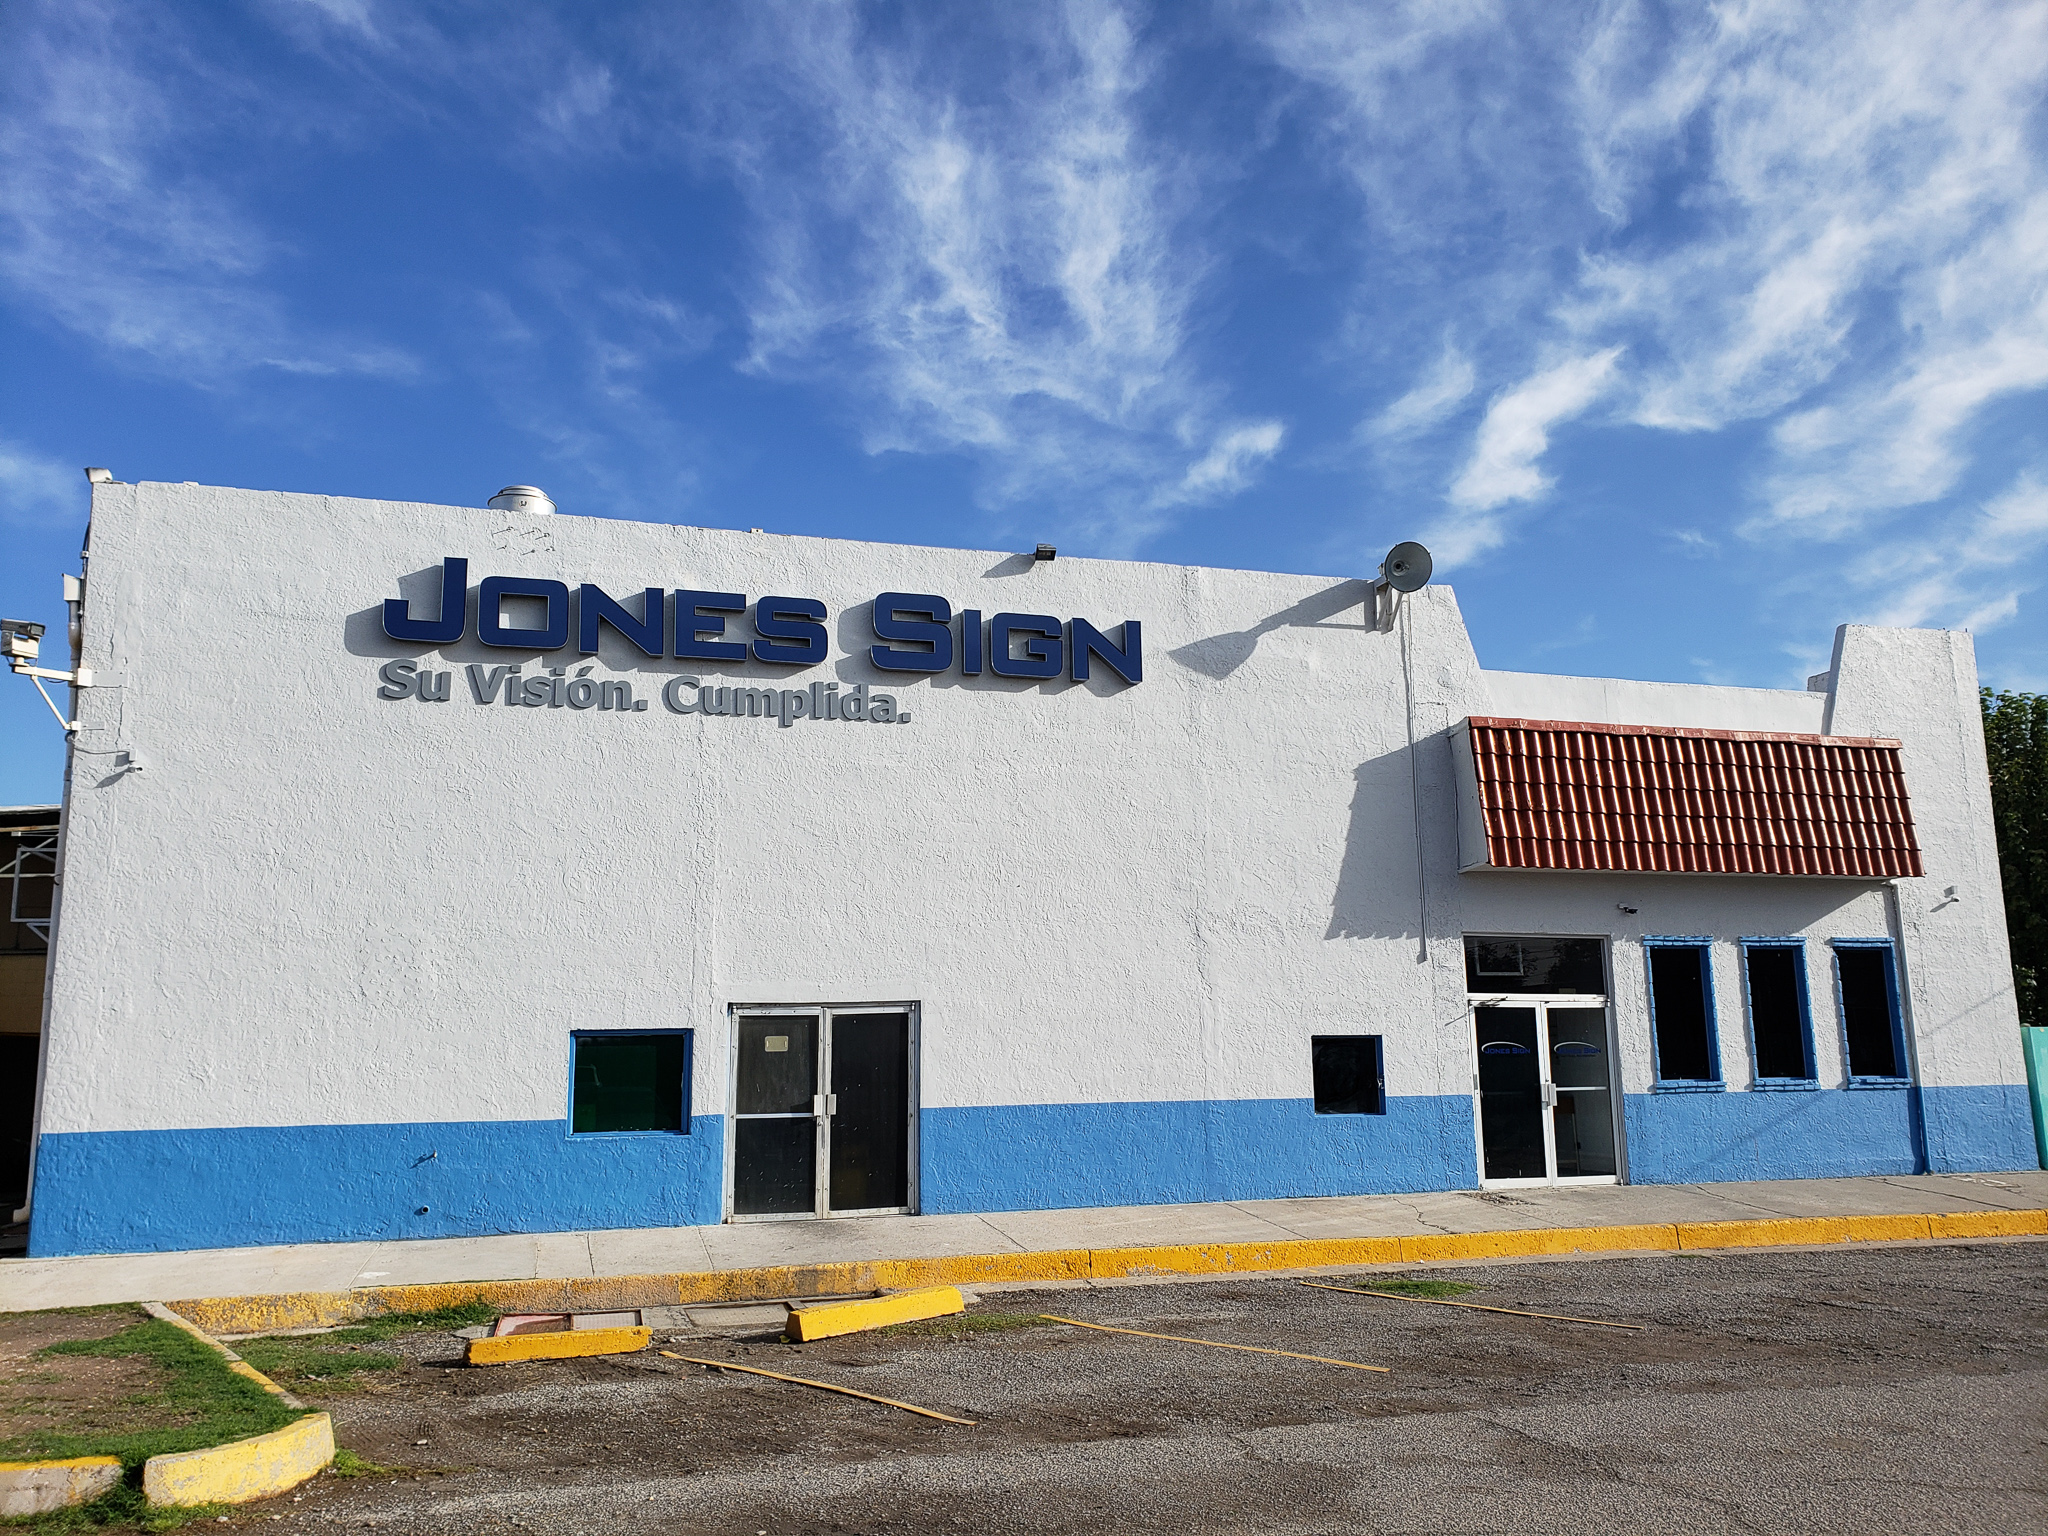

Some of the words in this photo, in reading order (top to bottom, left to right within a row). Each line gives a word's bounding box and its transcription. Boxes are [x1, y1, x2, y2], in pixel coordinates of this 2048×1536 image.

[383, 557, 828, 665] JONES
[870, 591, 1143, 685] SIGN
[380, 658, 451, 702] Su
[467, 664, 648, 711] Visión.
[665, 675, 911, 727] Cumplida.
